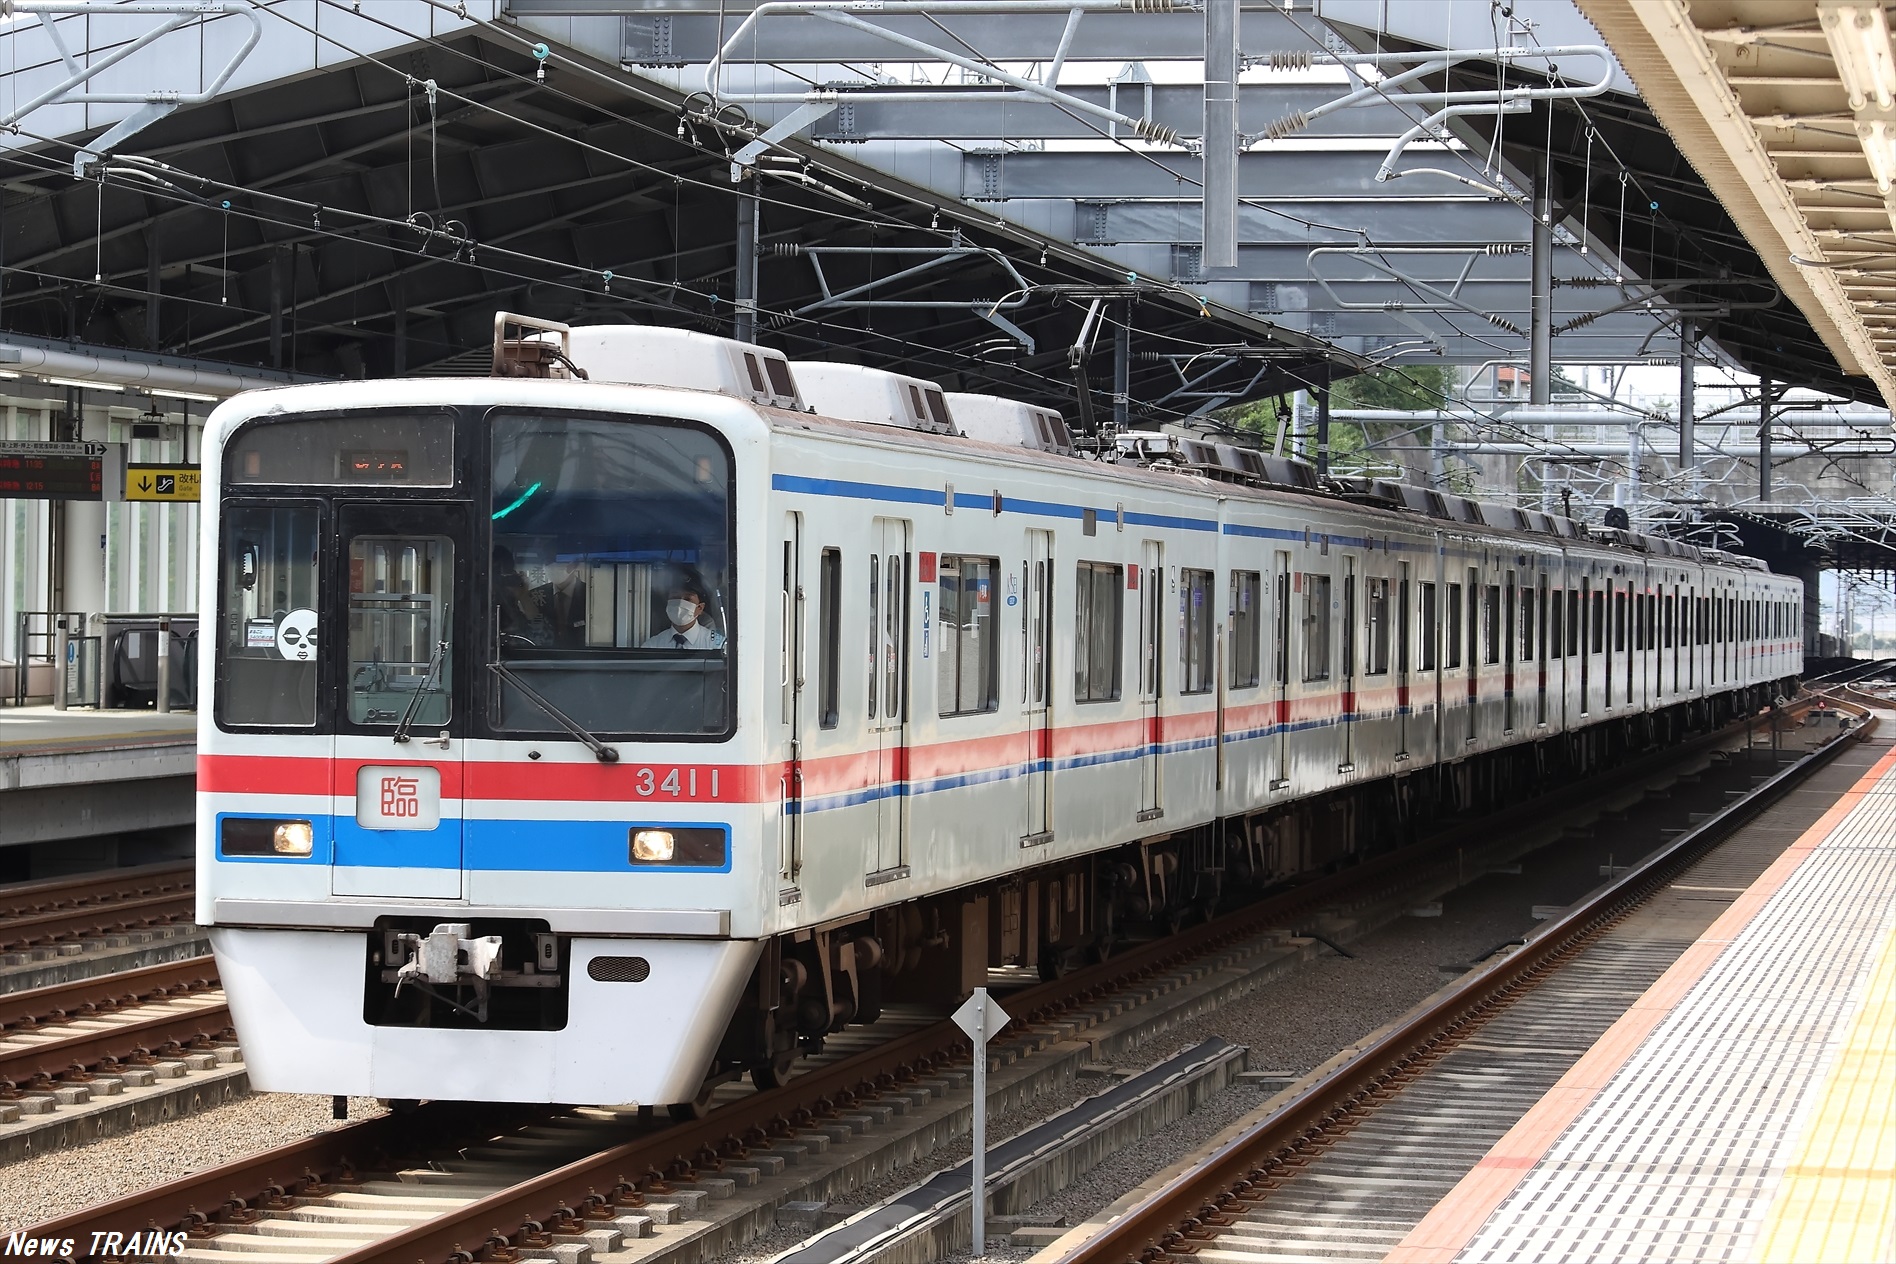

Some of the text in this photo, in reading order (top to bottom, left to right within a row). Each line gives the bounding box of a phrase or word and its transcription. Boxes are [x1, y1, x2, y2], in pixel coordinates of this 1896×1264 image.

[179, 473, 201, 484] 改札
[381, 775, 419, 818] 臨
[635, 767, 719, 797] 3411
